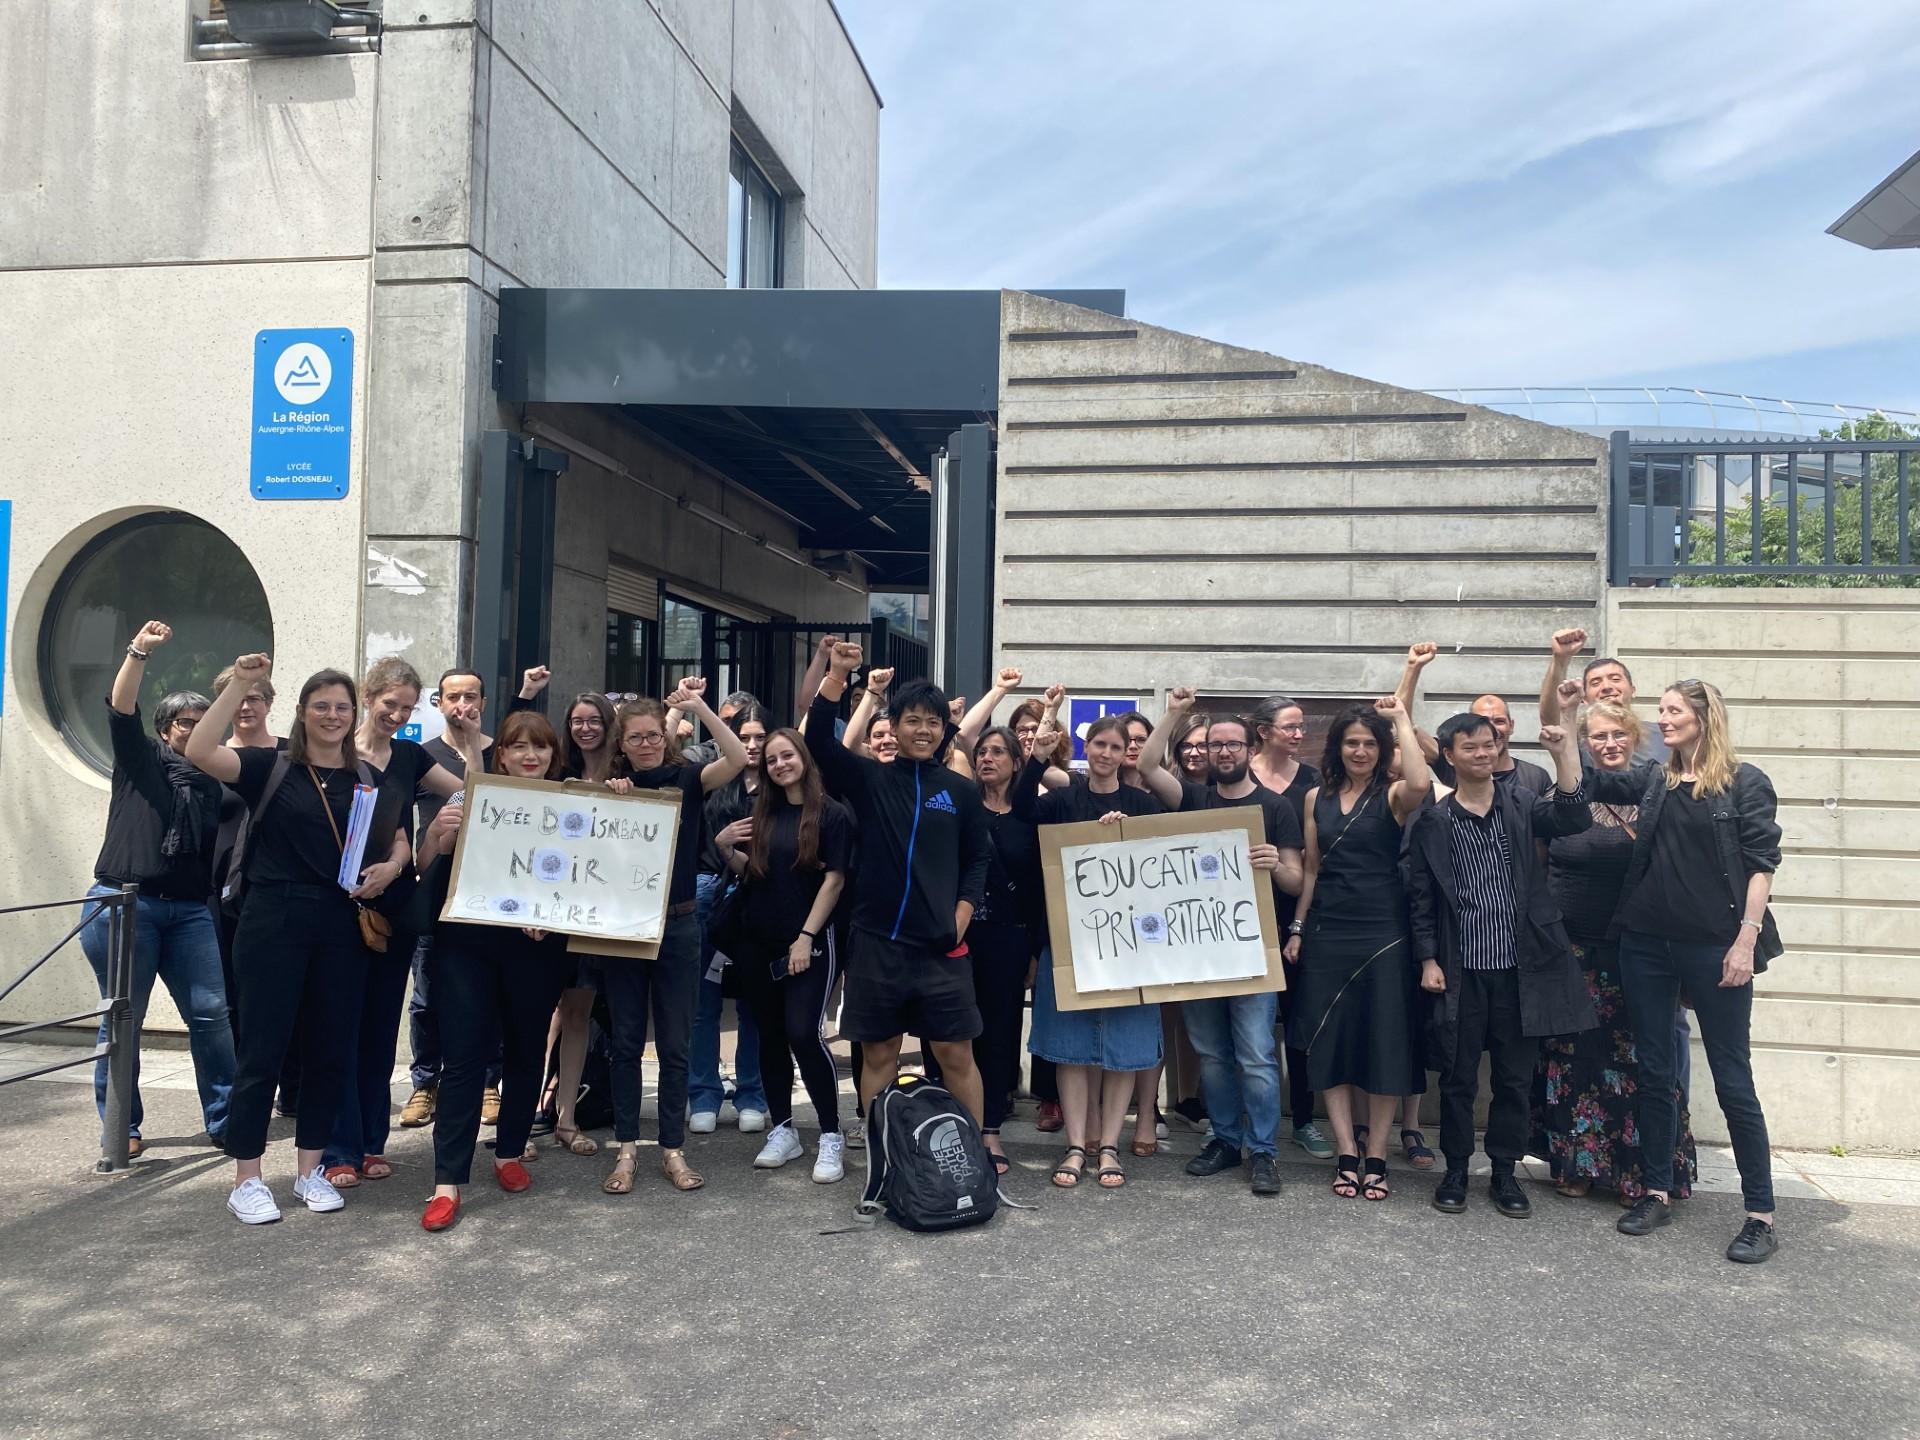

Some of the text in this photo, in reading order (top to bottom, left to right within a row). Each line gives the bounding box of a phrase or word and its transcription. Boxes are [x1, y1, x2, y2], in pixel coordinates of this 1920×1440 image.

[273, 411, 330, 424] La Région
[258, 424, 345, 435] Auvergne-Rhône-Alpes
[287, 462, 312, 470] LYCÉE
[265, 476, 333, 484] Robert DOISNEAU
[925, 801, 956, 814] adidas
[480, 799, 531, 830] LYCÉE
[933, 1150, 950, 1176] THE
[952, 1144, 974, 1177] FACE
